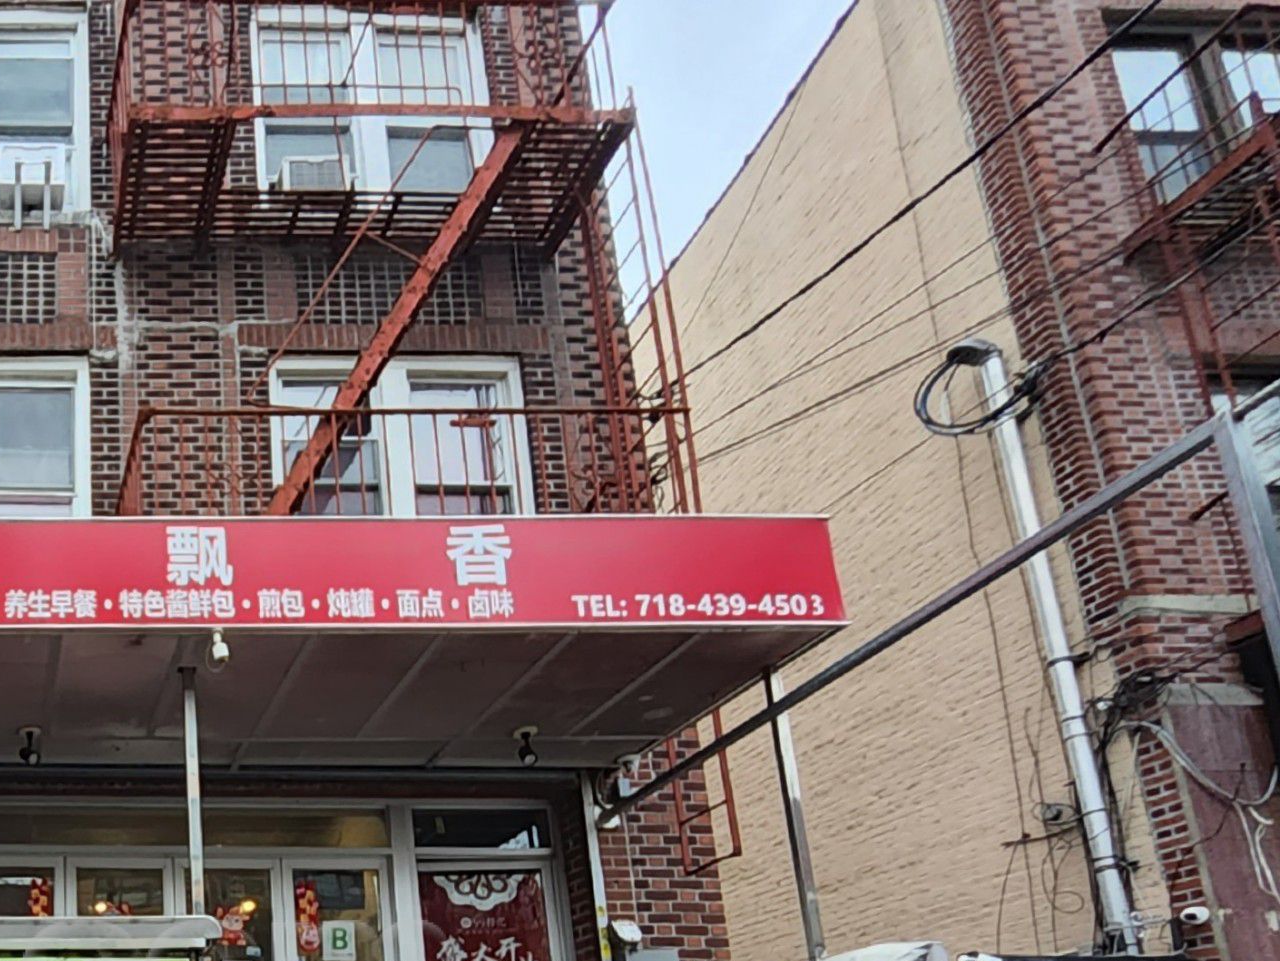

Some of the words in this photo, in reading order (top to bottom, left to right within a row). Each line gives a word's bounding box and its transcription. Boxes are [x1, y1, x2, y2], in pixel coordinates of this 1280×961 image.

[4, 588, 98, 619] 养生早餐
[257, 588, 305, 618] 煎包
[395, 588, 444, 618] 面点
[468, 588, 514, 618] 卤味
[571, 594, 628, 617] TEL:
[634, 593, 825, 616] 718-439-4503
[332, 927, 348, 950] B
